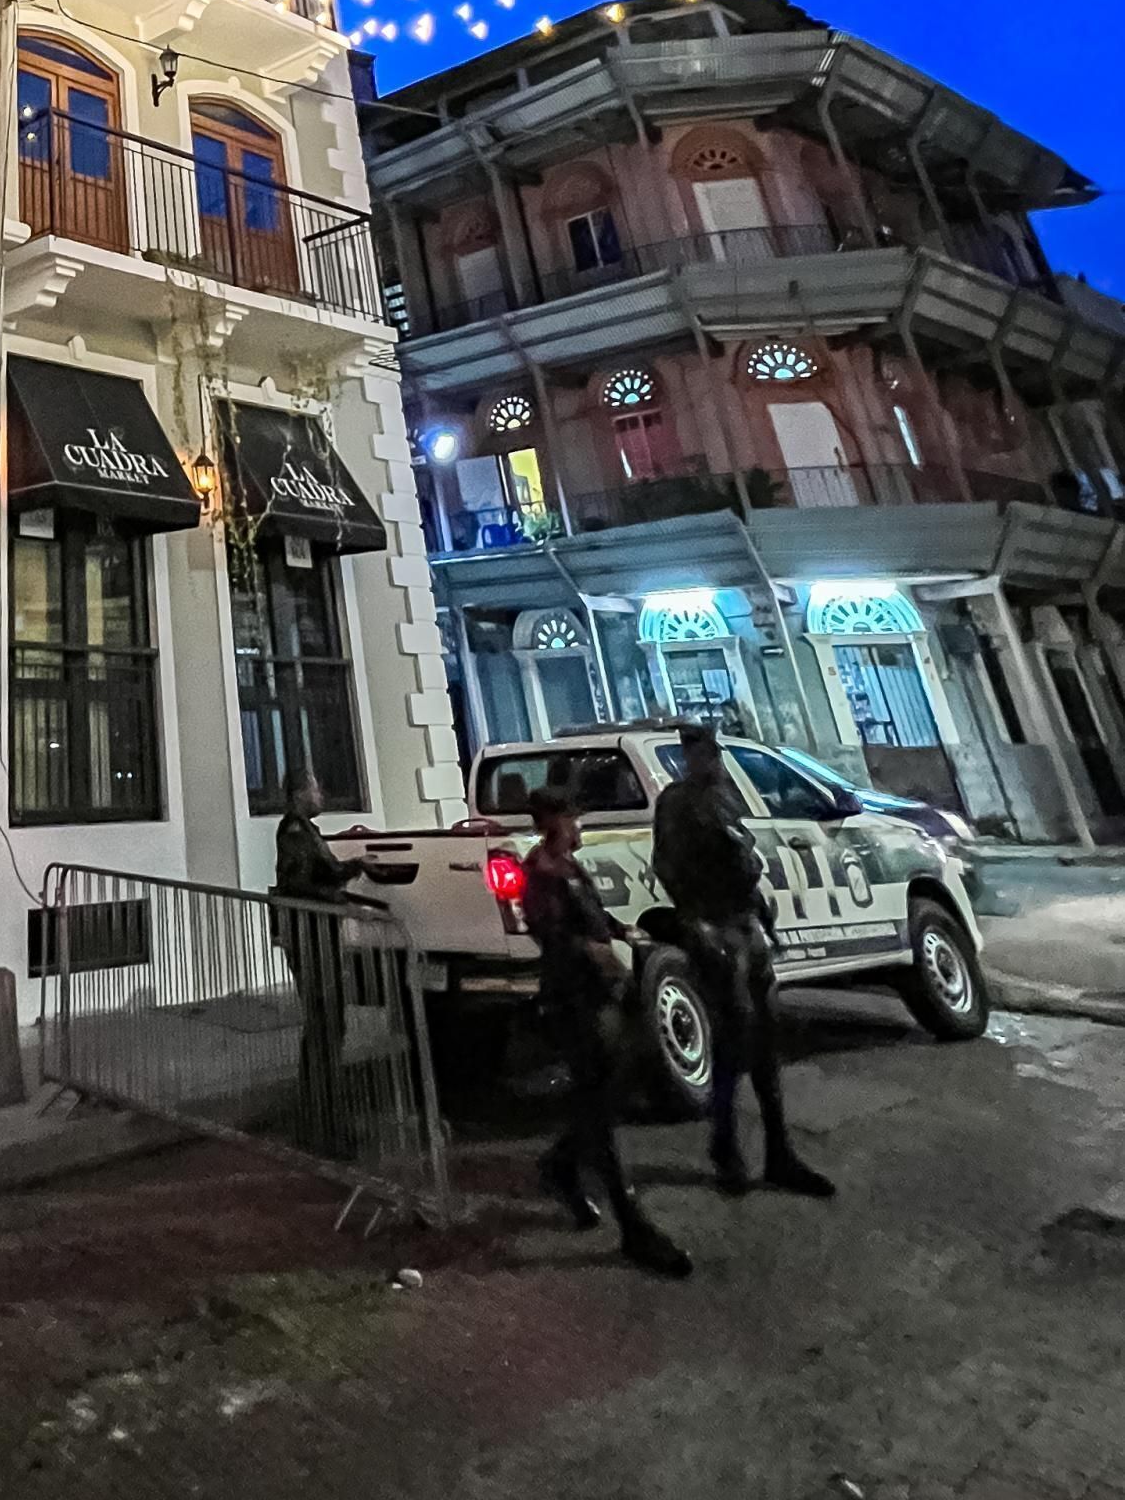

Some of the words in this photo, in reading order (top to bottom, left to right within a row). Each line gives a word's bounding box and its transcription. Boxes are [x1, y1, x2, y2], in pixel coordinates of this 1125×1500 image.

[86, 428, 127, 452] LA
[64, 444, 169, 478] CUADRA
[284, 462, 318, 484] LA
[97, 468, 149, 484] MARKET
[271, 476, 355, 506] CUADRA
